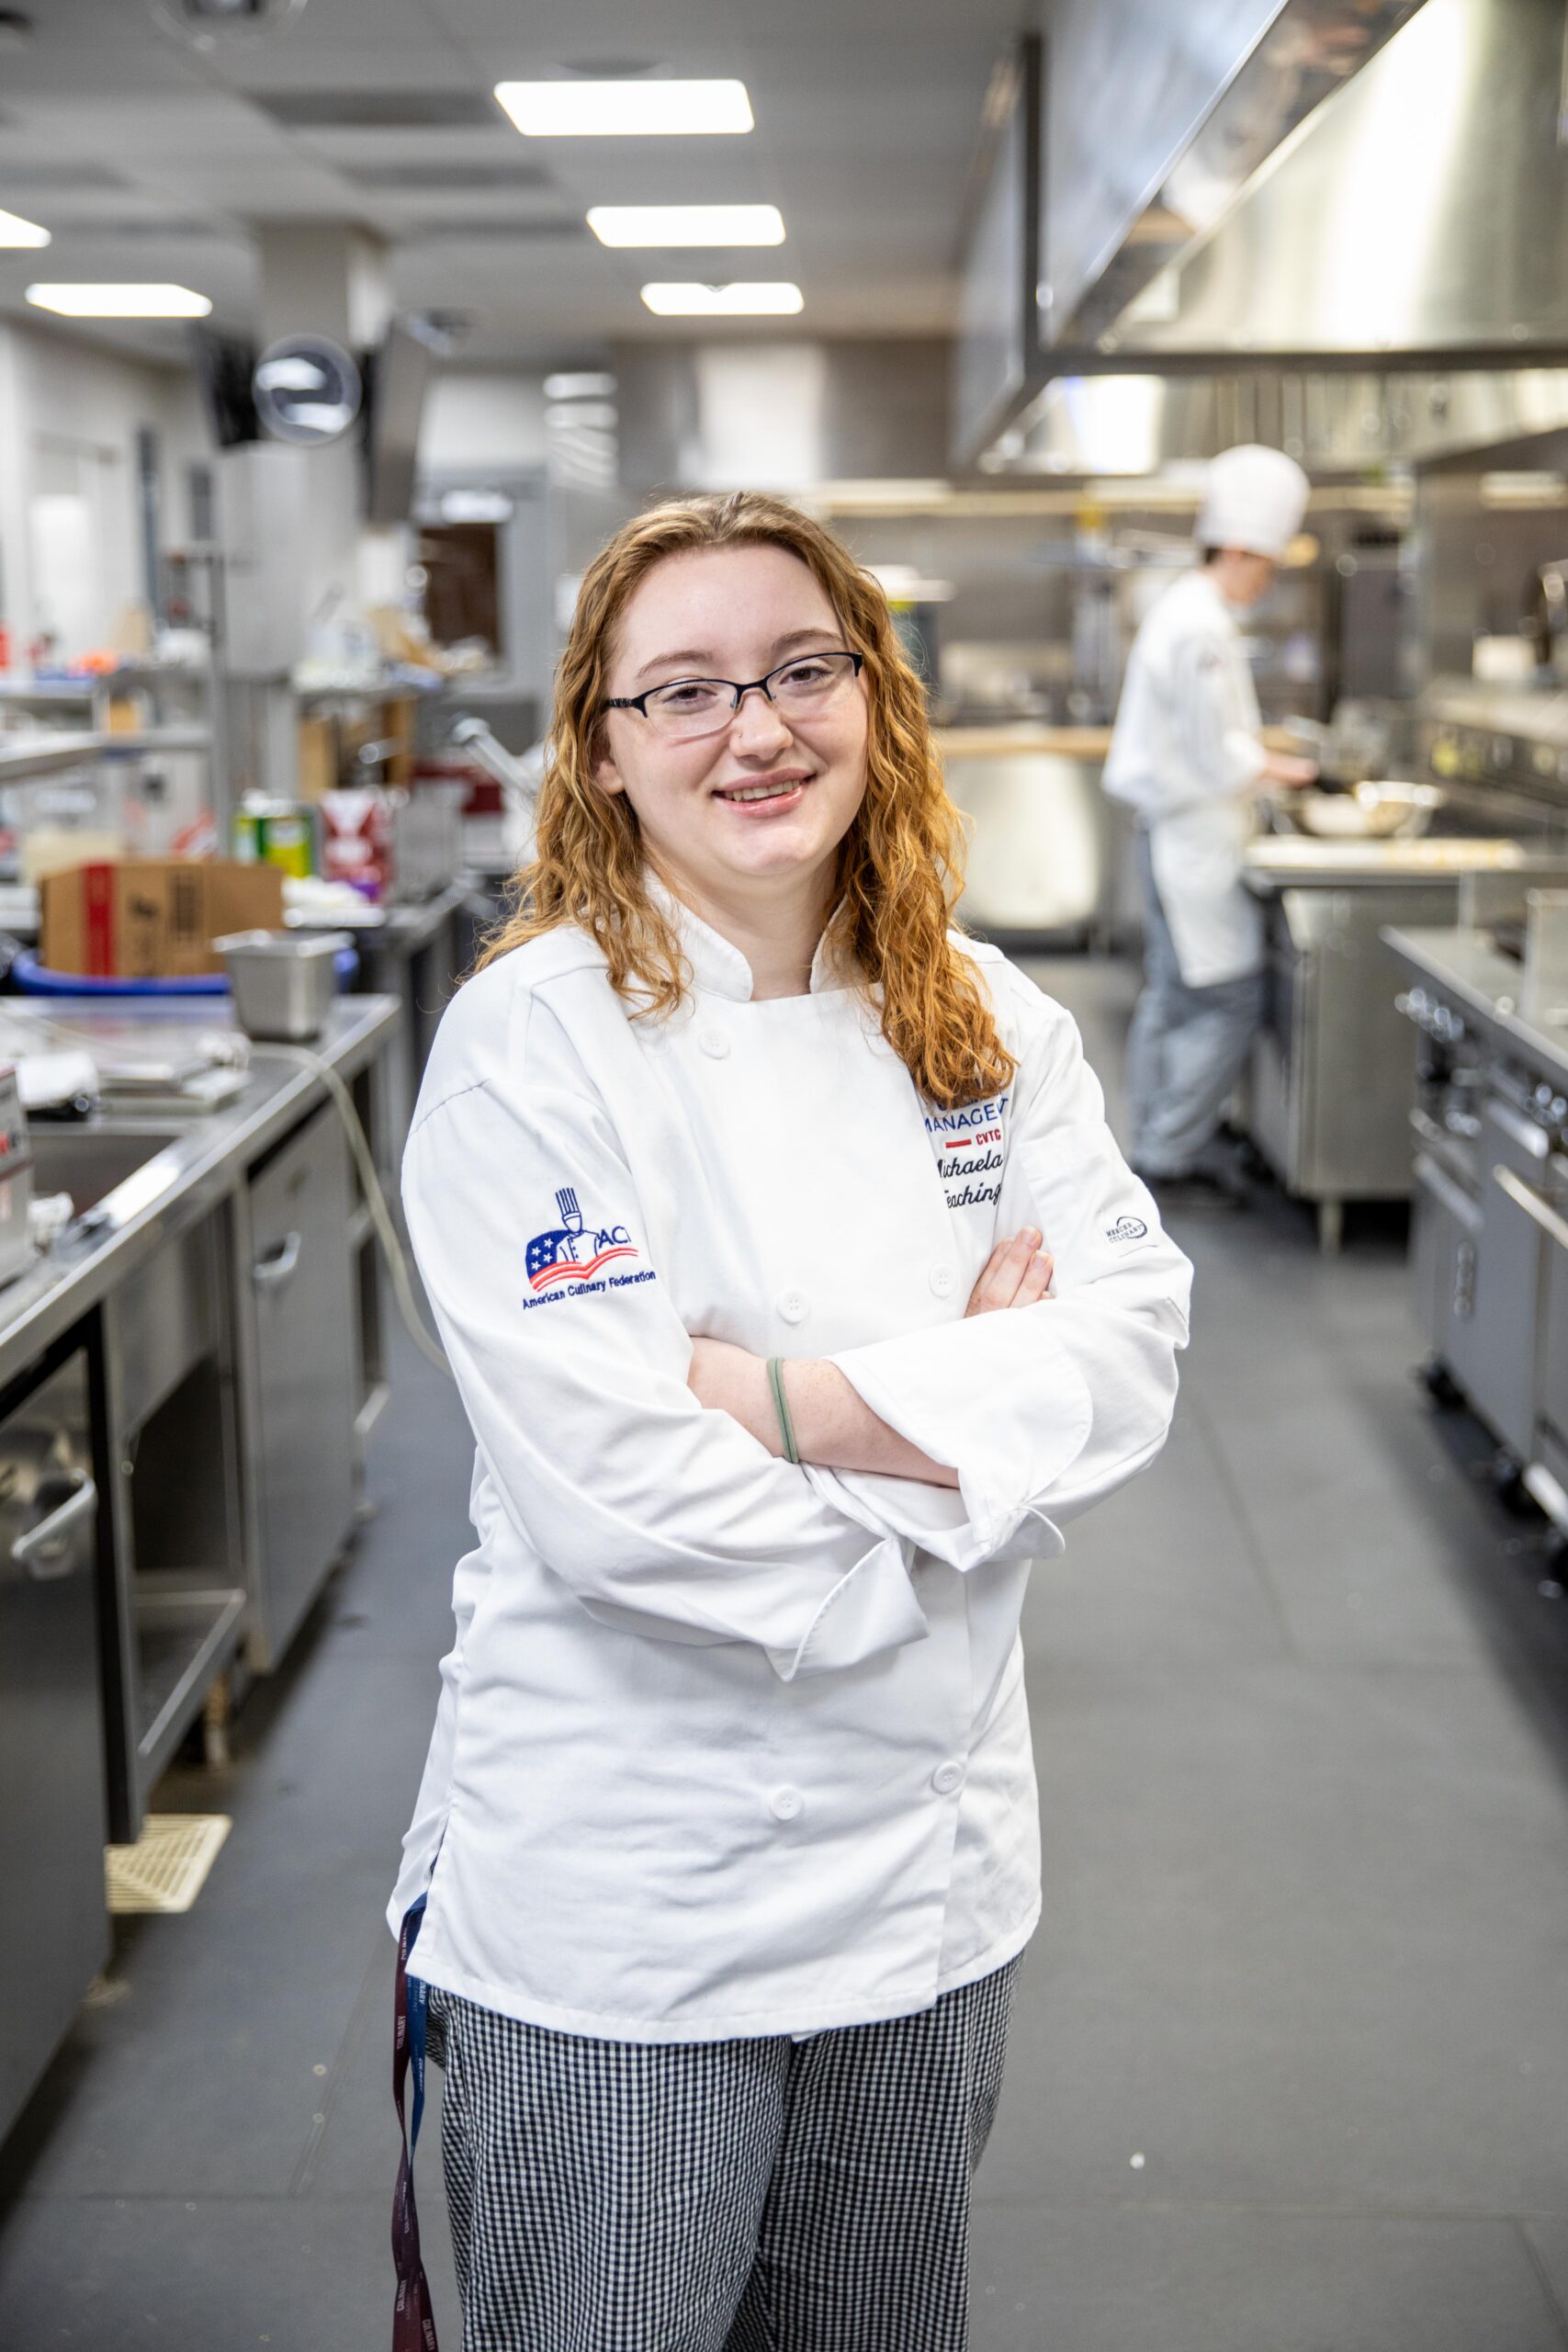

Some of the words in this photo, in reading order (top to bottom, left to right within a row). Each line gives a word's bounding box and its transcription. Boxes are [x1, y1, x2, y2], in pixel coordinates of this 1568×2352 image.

[976, 1128, 1001, 1146] CVTC
[944, 1182, 1002, 1209] eaching
[1106, 1222, 1133, 1238] MERCER
[523, 1290, 566, 1310] American
[567, 1280, 606, 1296] Culinary
[609, 1271, 656, 1287] Federation
[397, 2015, 406, 2050] CULINARY
[397, 2279, 407, 2312] CULINARY
[423, 2318, 435, 2350] CULINARY
